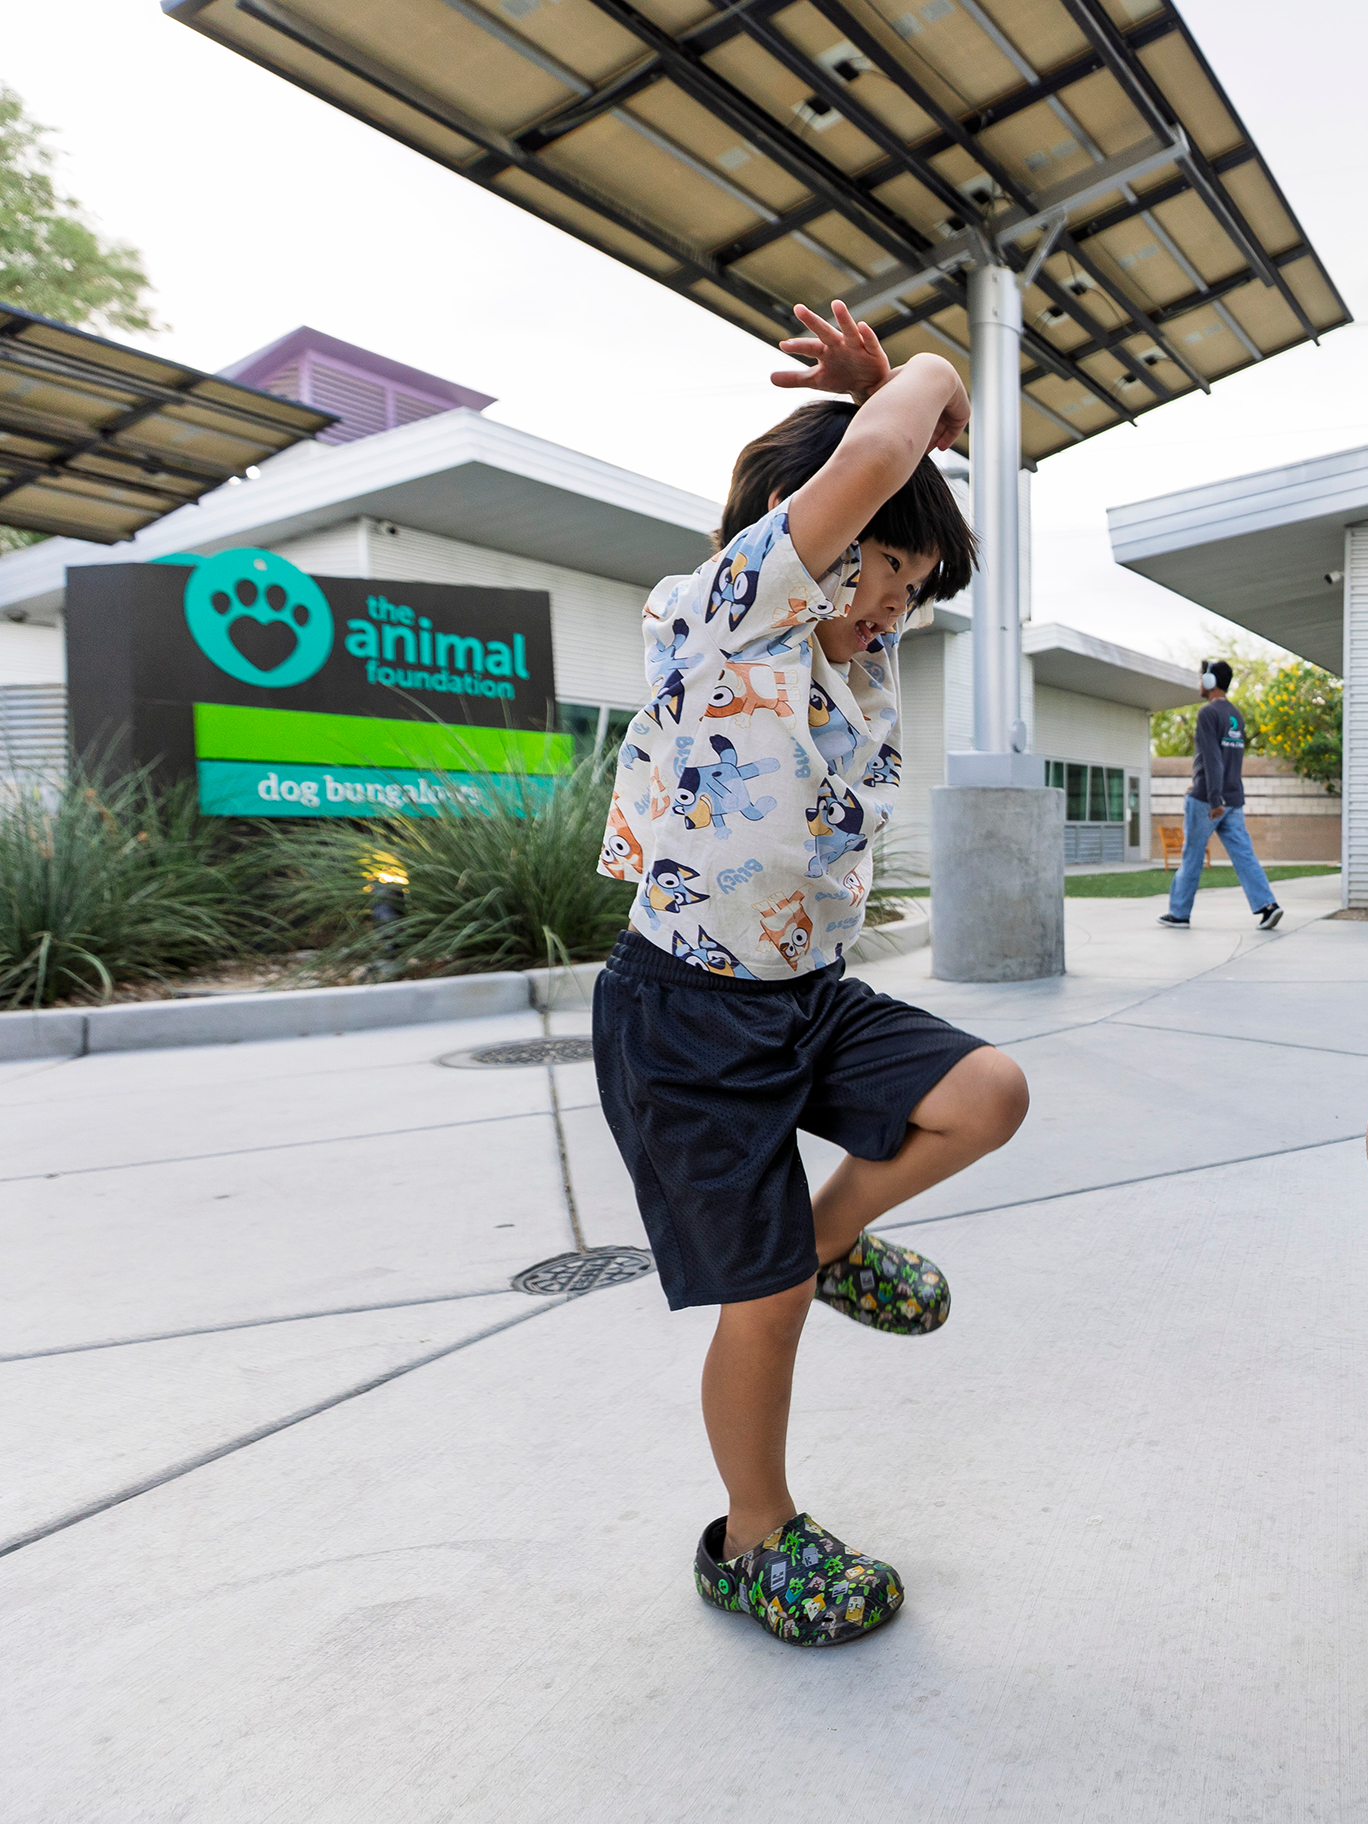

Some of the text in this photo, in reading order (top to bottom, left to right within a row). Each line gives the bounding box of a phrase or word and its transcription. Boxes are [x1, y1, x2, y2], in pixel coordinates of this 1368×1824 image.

[366, 595, 415, 626] the
[345, 616, 530, 680] animal
[365, 658, 516, 700] foundation
[257, 772, 321, 809] dog
